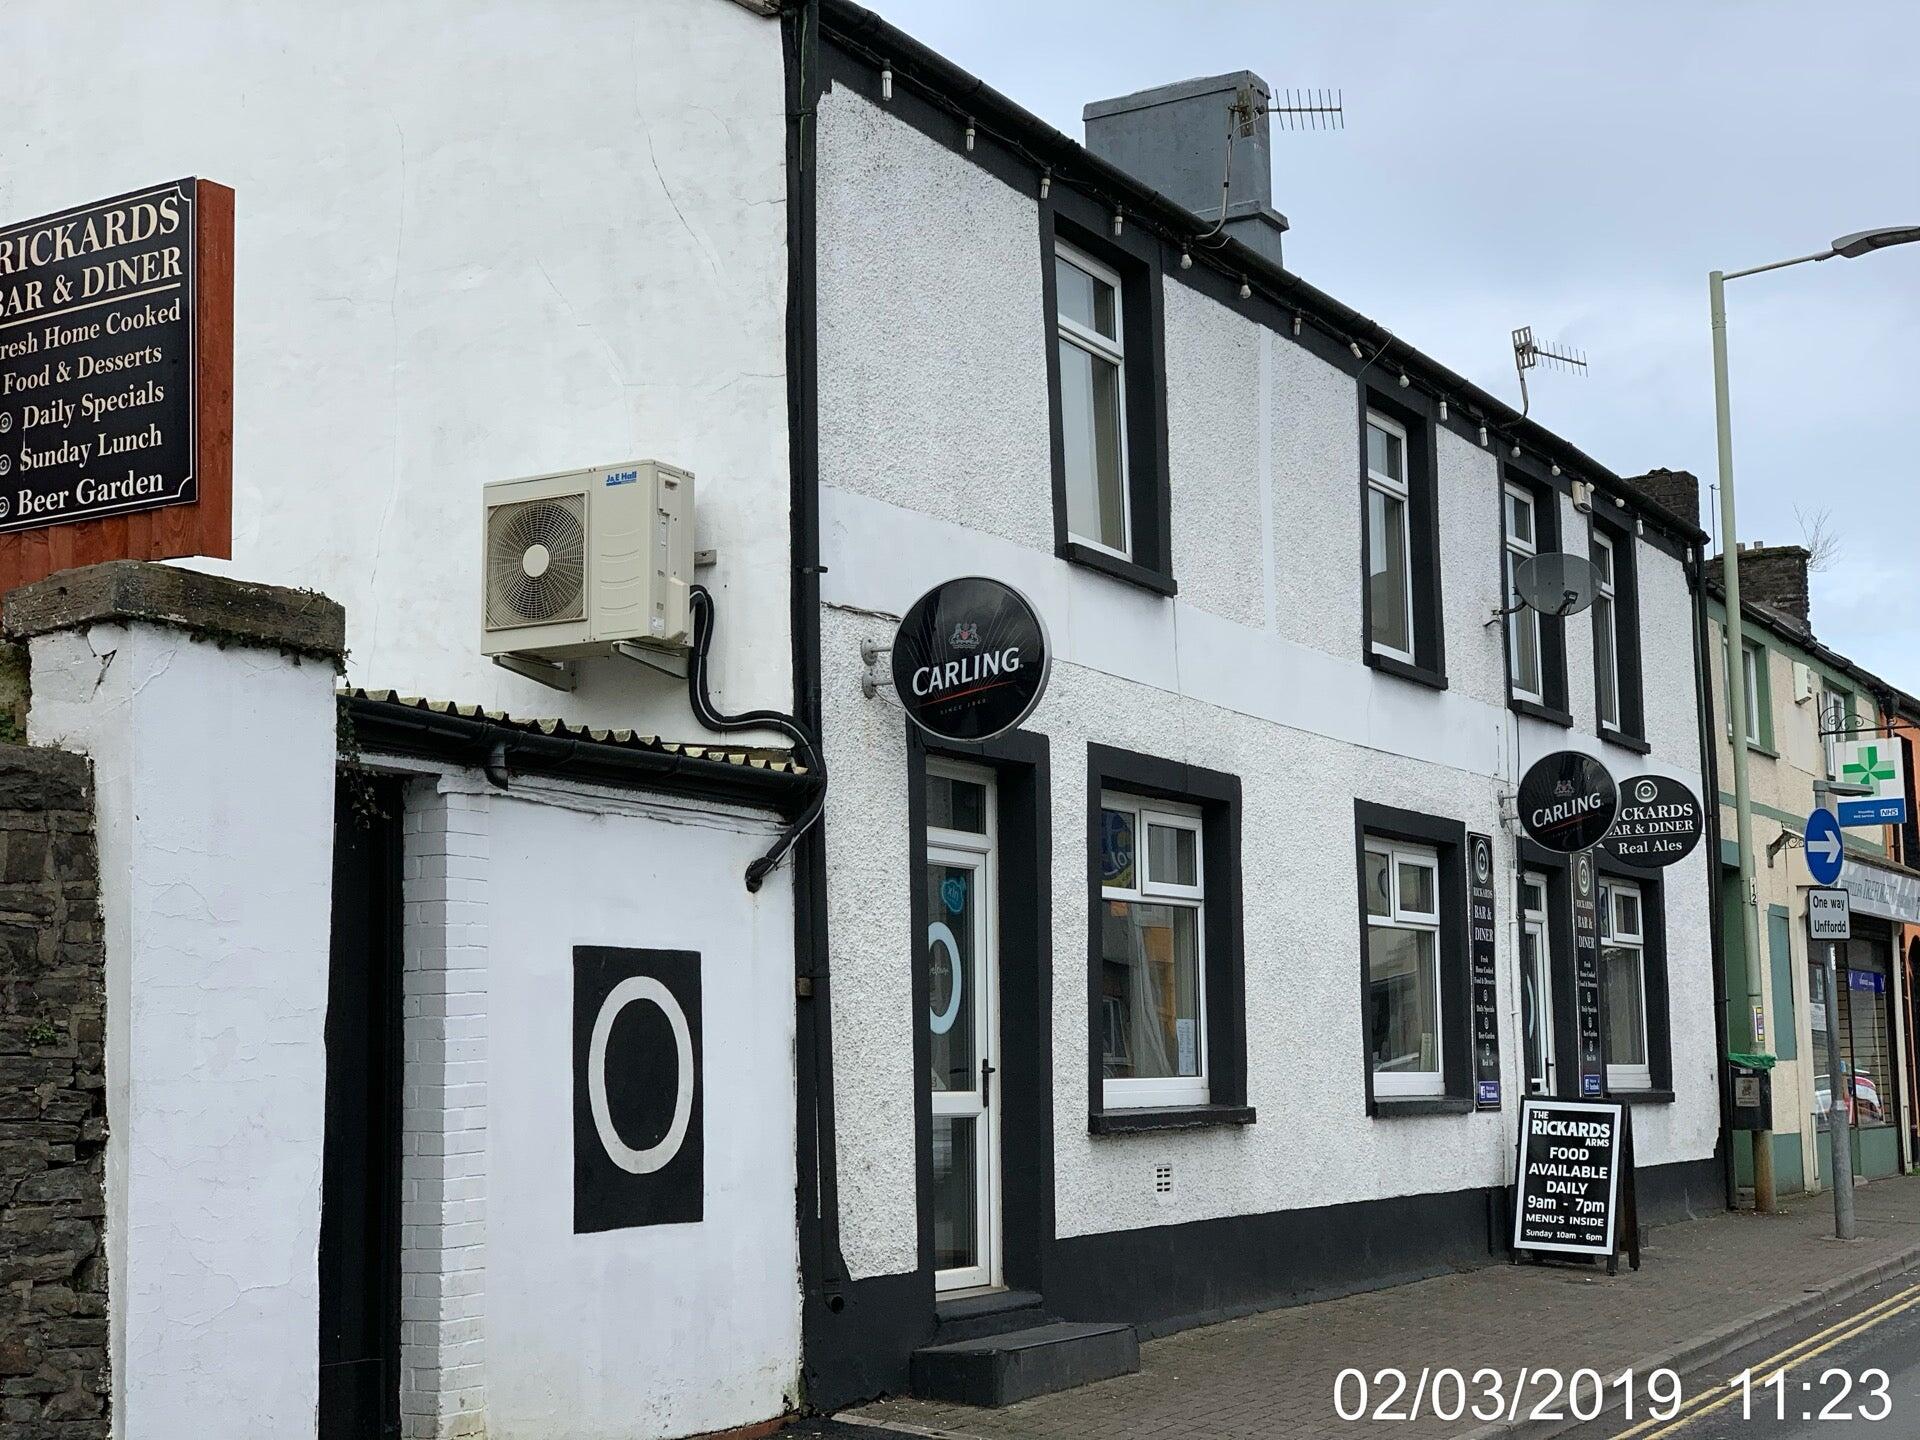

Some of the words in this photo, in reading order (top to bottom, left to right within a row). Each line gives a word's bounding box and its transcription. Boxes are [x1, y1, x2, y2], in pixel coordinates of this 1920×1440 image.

[0, 196, 180, 276] RICKARDS
[53, 274, 73, 305] &
[81, 247, 183, 298] DINER
[0, 332, 38, 360] resh
[44, 325, 100, 351] Home
[106, 298, 181, 335] Cooked
[3, 365, 50, 395] Food
[56, 361, 71, 383] &
[77, 345, 162, 379] Desserts
[22, 399, 76, 430] Daily
[81, 380, 164, 422] Specials
[20, 440, 92, 471] Sunday
[97, 423, 163, 457] Lunch
[17, 489, 69, 516] Beer
[76, 470, 164, 505] Garden
[912, 647, 1020, 697] CARLING
[1532, 792, 1601, 828] CARLING
[1609, 824, 1631, 835] AR
[1635, 823, 1645, 834] &
[1649, 820, 1694, 833] DINER
[1618, 842, 1648, 855] Real
[1652, 839, 1683, 852] Ales
[1813, 895, 1828, 909] One
[1831, 898, 1845, 911] way
[1474, 905, 1487, 919] BAR
[1814, 919, 1847, 933] Unffordd
[1475, 927, 1494, 942] DINER
[1578, 936, 1595, 949] DINER
[1532, 1110, 1549, 1119] THE
[1531, 1120, 1610, 1138] RICKARDS
[1585, 1138, 1610, 1147] ARMS
[1549, 1146, 1589, 1160] FOOD
[1528, 1162, 1608, 1179] AVAILABLE
[1546, 1180, 1588, 1195] DAILY
[1528, 1195, 1556, 1210] 9am
[1575, 1198, 1605, 1214] 7pm
[1525, 1213, 1565, 1224] MENU'S
[1569, 1216, 1604, 1227] INSIDE
[1526, 1229, 1553, 1239] Sunday
[1556, 1231, 1576, 1239] 10am
[1585, 1233, 1603, 1242] 6pm
